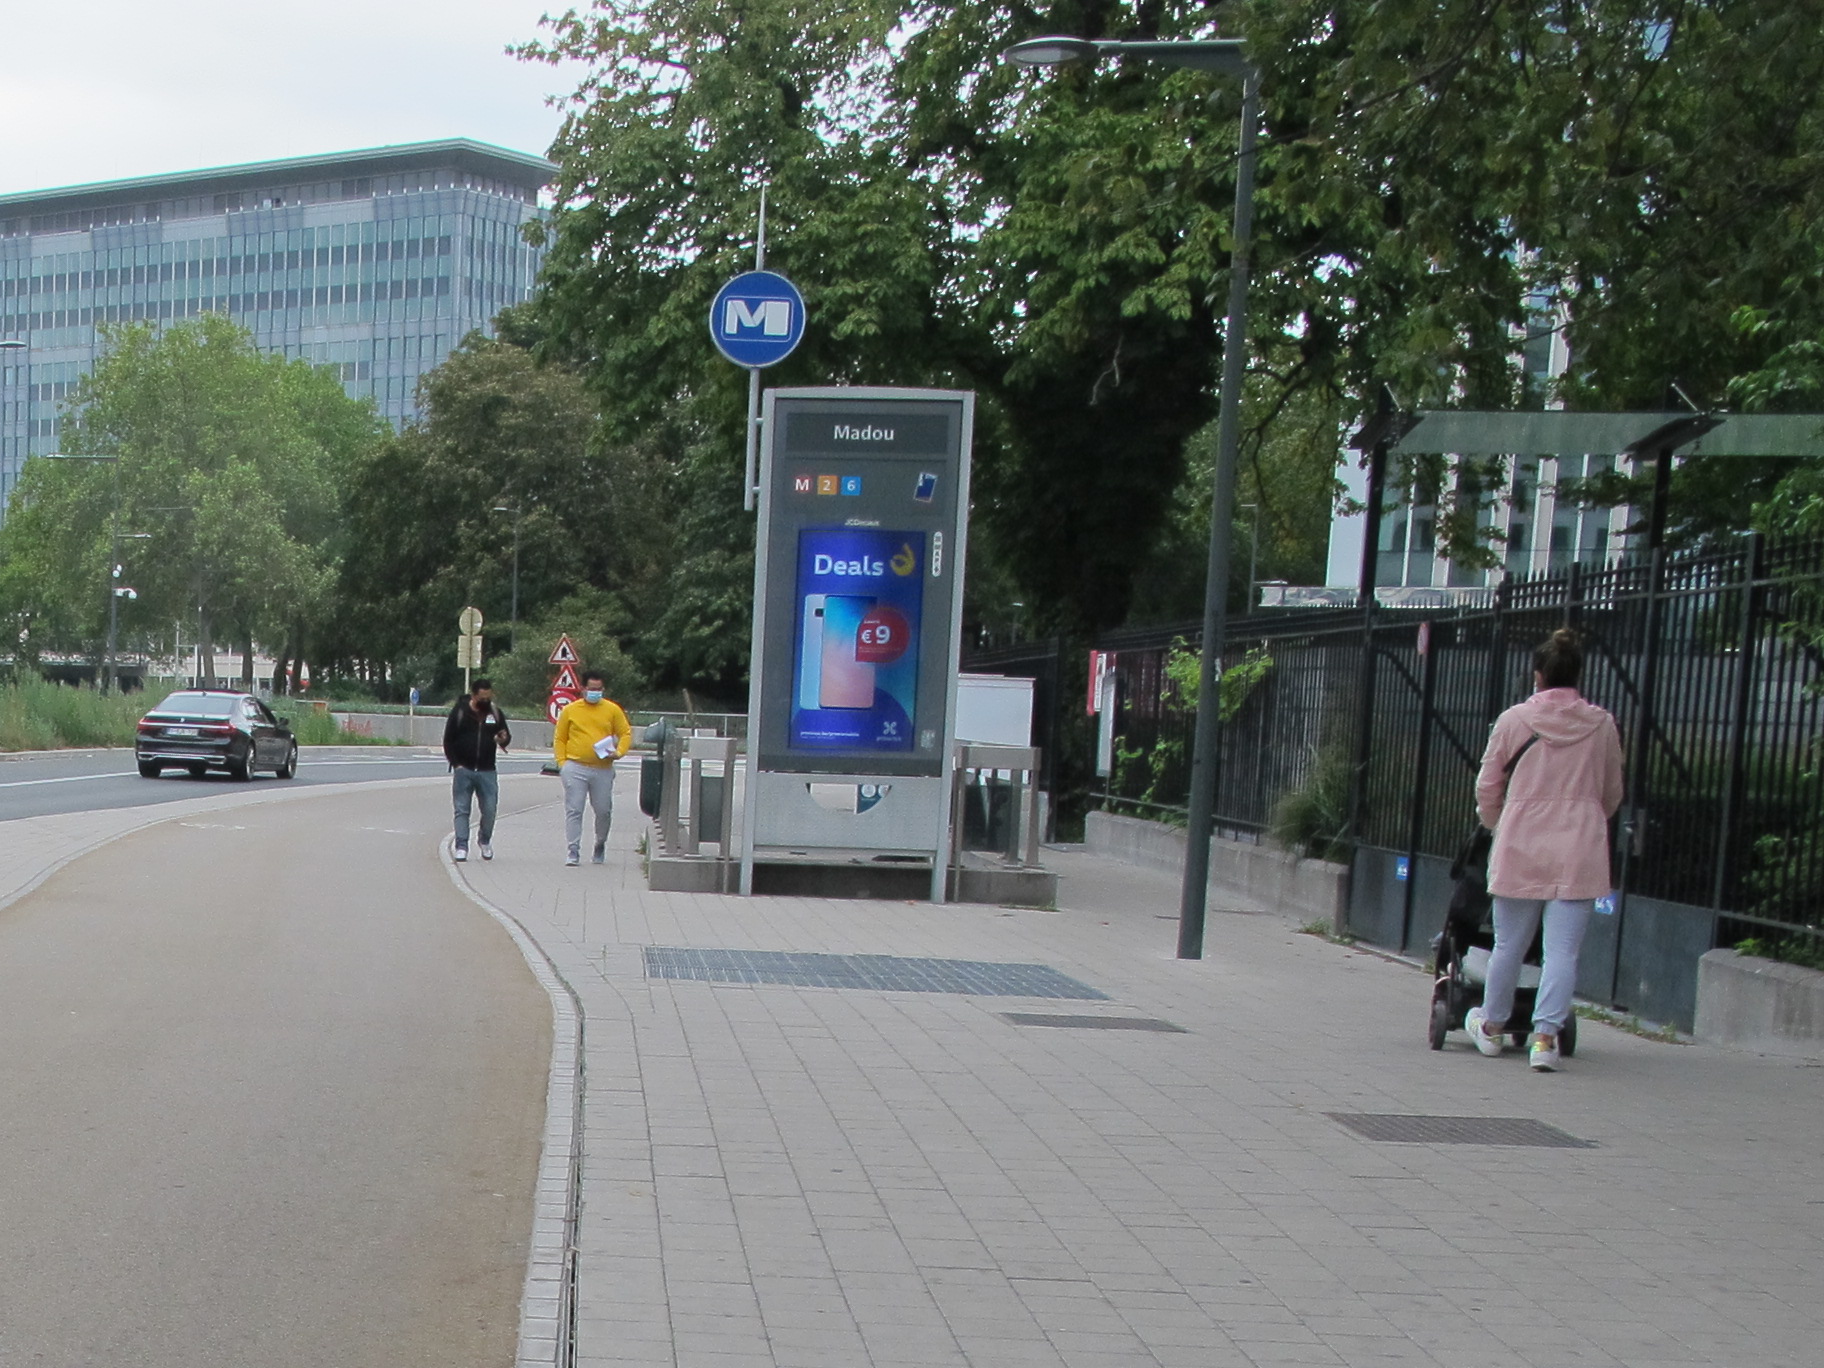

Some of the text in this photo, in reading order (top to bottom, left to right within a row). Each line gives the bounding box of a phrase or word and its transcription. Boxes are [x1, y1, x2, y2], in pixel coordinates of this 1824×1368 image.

[725, 300, 790, 336] M
[833, 425, 895, 441] Madou
[795, 479, 855, 491] M 2 6
[814, 553, 884, 577] Deals
